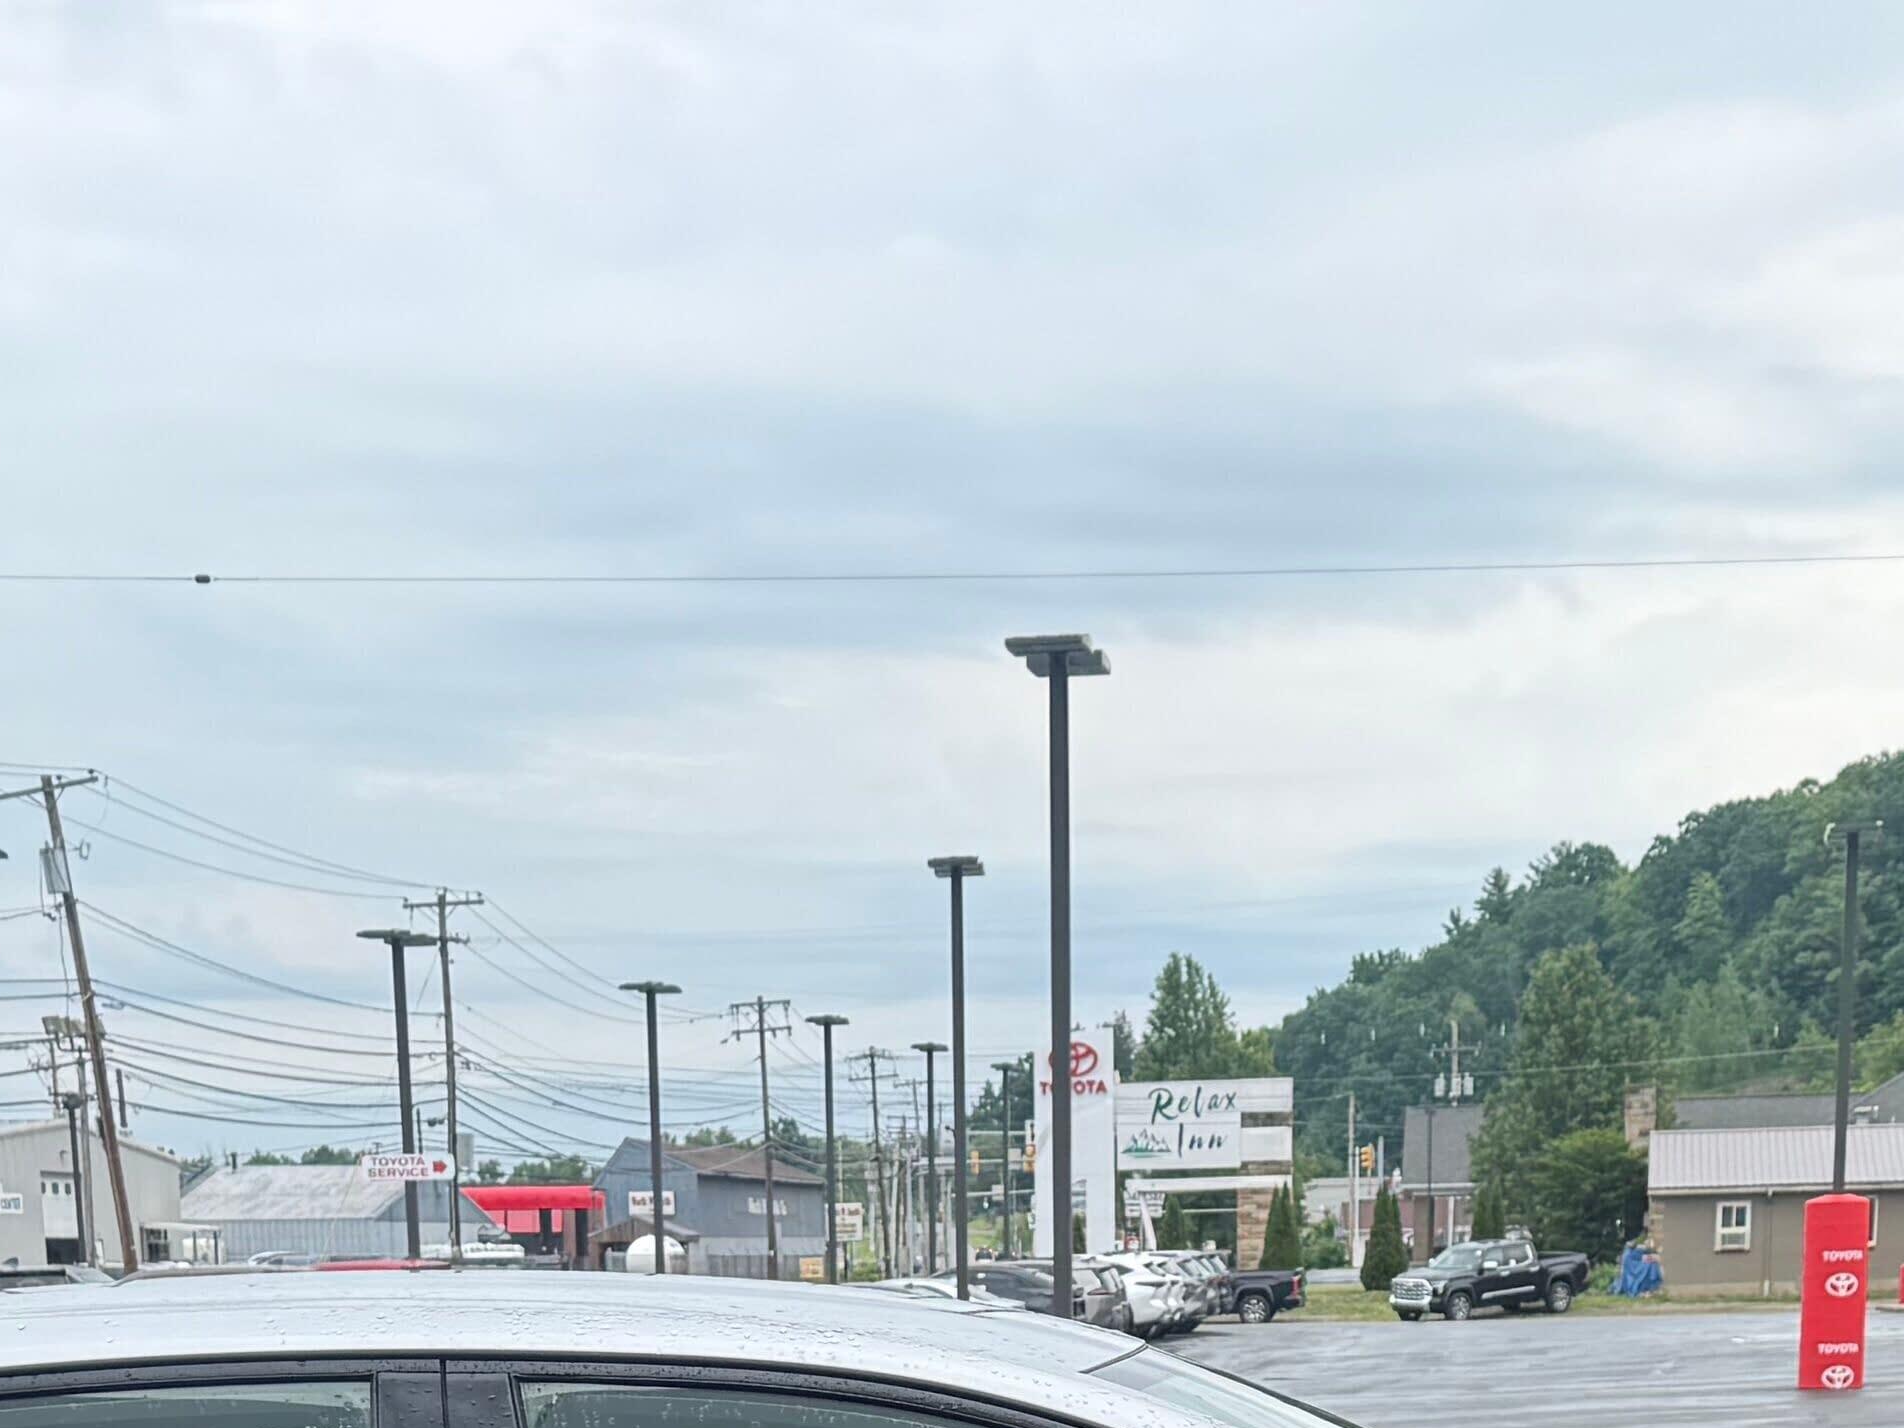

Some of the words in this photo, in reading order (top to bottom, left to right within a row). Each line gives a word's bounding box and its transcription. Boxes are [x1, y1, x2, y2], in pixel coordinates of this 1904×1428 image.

[1040, 1079, 1108, 1095] TOTA
[1148, 1086, 1237, 1125] Relax
[1178, 1122, 1229, 1158] Inn
[371, 1156, 425, 1166] TOYOTA
[368, 1167, 428, 1177] SERVICE
[1822, 1249, 1863, 1262] TOYOTA
[1818, 1343, 1859, 1355] TOYOTA
